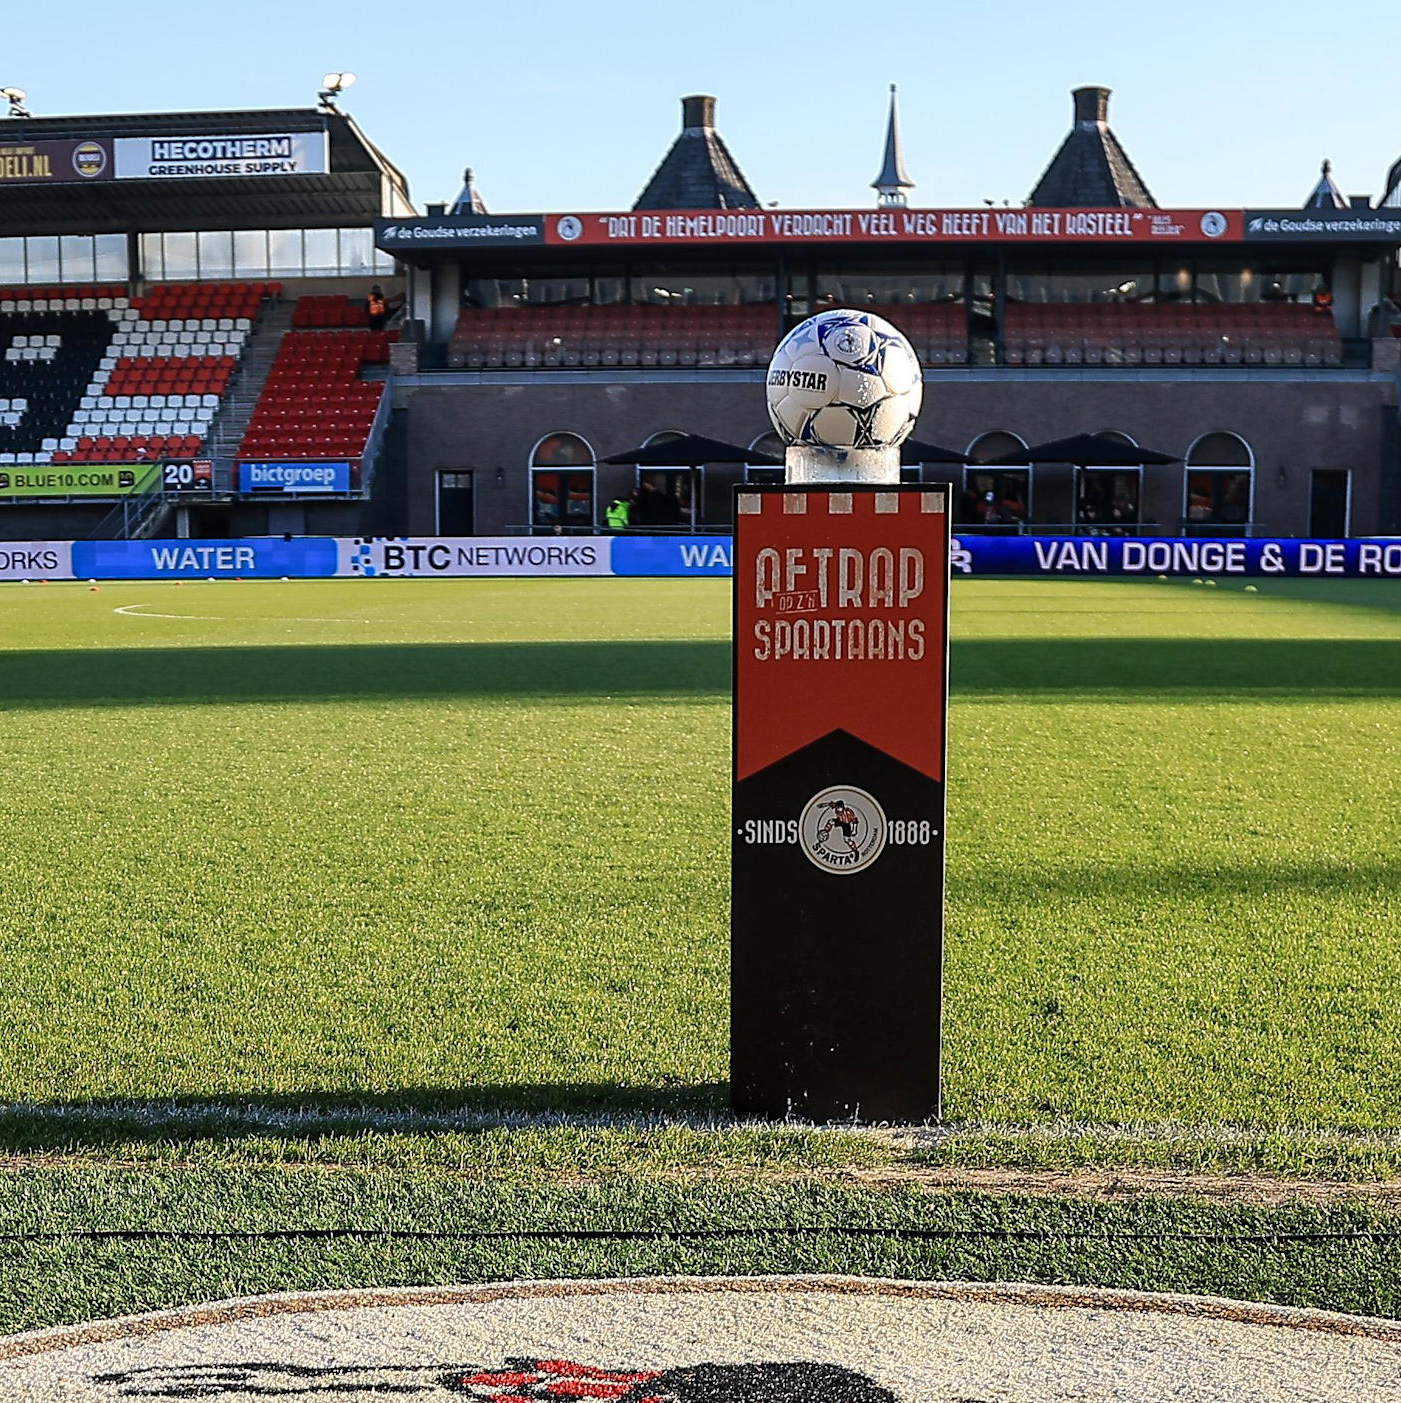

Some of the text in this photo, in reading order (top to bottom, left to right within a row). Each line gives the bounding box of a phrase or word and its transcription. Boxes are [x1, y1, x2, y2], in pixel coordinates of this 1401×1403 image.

[153, 138, 290, 161] HECOTHERM
[149, 160, 297, 175] GREENHOUSE SUPPLY
[398, 225, 537, 238] de Goudse verzekeringen
[642, 215, 661, 237] DE
[666, 214, 765, 237] HEMELPOORT
[771, 214, 852, 236] VERDACHT
[858, 214, 897, 235] VEEL
[902, 213, 937, 235] WEG
[942, 213, 988, 235] HEEFT
[995, 213, 1028, 235] VAN
[1032, 213, 1060, 235] HET
[1264, 220, 1278, 231] de
[1280, 219, 1324, 231] Goudse
[16, 473, 113, 488] BLUE10.COM
[165, 465, 193, 483] 20
[251, 464, 335, 485] bictgroep
[152, 547, 255, 570] WATER
[384, 545, 596, 571] BTC NETWORKS
[1035, 541, 1107, 569] VAN
[1123, 542, 1245, 571] DONGE
[1260, 543, 1285, 571] &
[1299, 544, 1345, 573] DE
[756, 547, 924, 608] AFTRAP
[754, 619, 925, 660] SPARTAANS
[745, 819, 798, 844] SINDS
[888, 820, 930, 845] 1888
[812, 842, 853, 865] SPARTA
